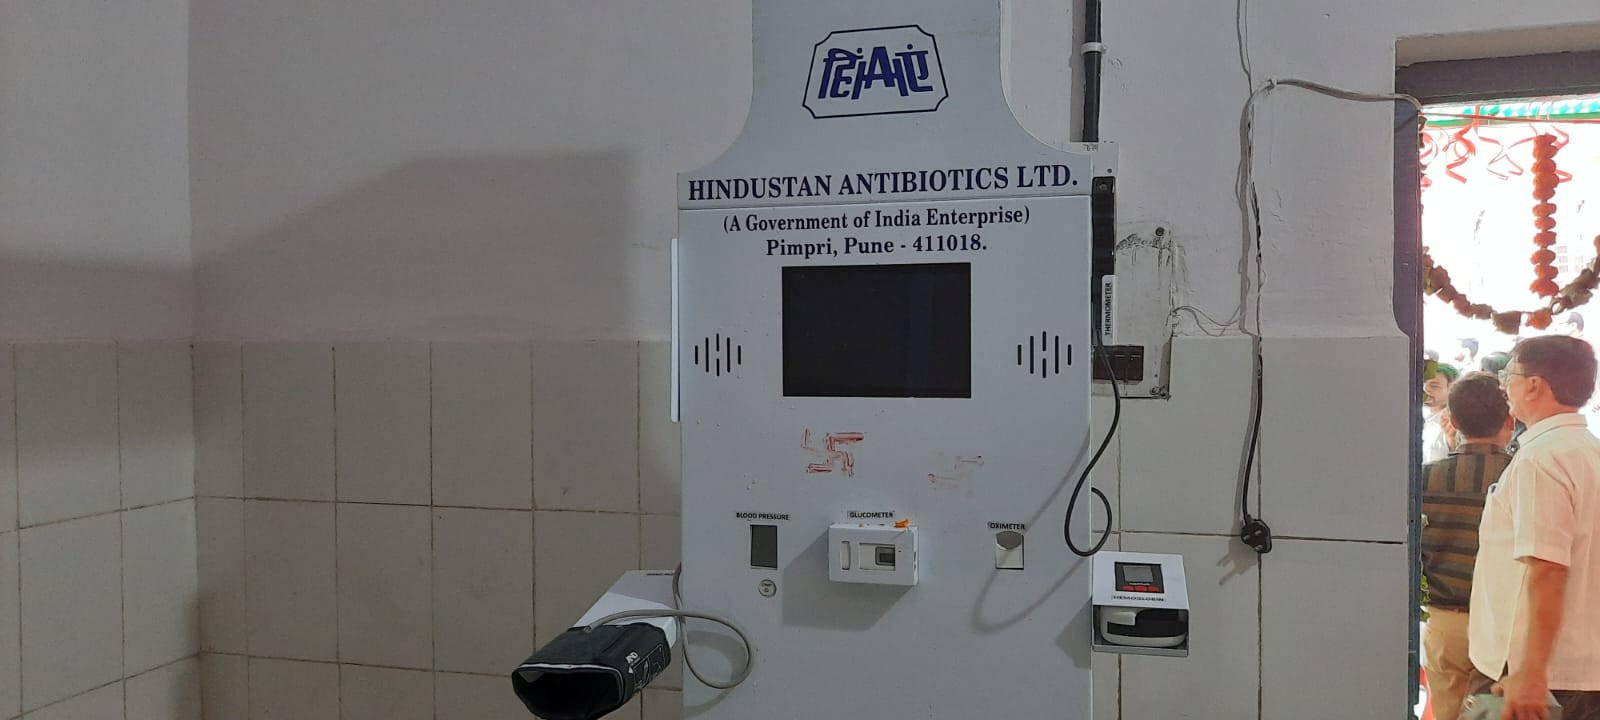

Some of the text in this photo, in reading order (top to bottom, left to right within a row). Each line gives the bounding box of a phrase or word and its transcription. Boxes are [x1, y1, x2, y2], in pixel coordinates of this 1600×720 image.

[687, 164, 1078, 201] HINDUSTAN ANTIBIOTICS LTD.
[723, 205, 1030, 233] (A Government of India Enterprise)
[765, 237, 838, 259] Pimpri,
[844, 236, 895, 254] Pune
[912, 233, 988, 252] 411018.
[1104, 282, 1112, 336] THERMOMETER
[736, 512, 790, 521] BLOOD PRESSURE
[849, 511, 894, 519] GLUCOMETER
[989, 522, 1026, 530] OXIMETER
